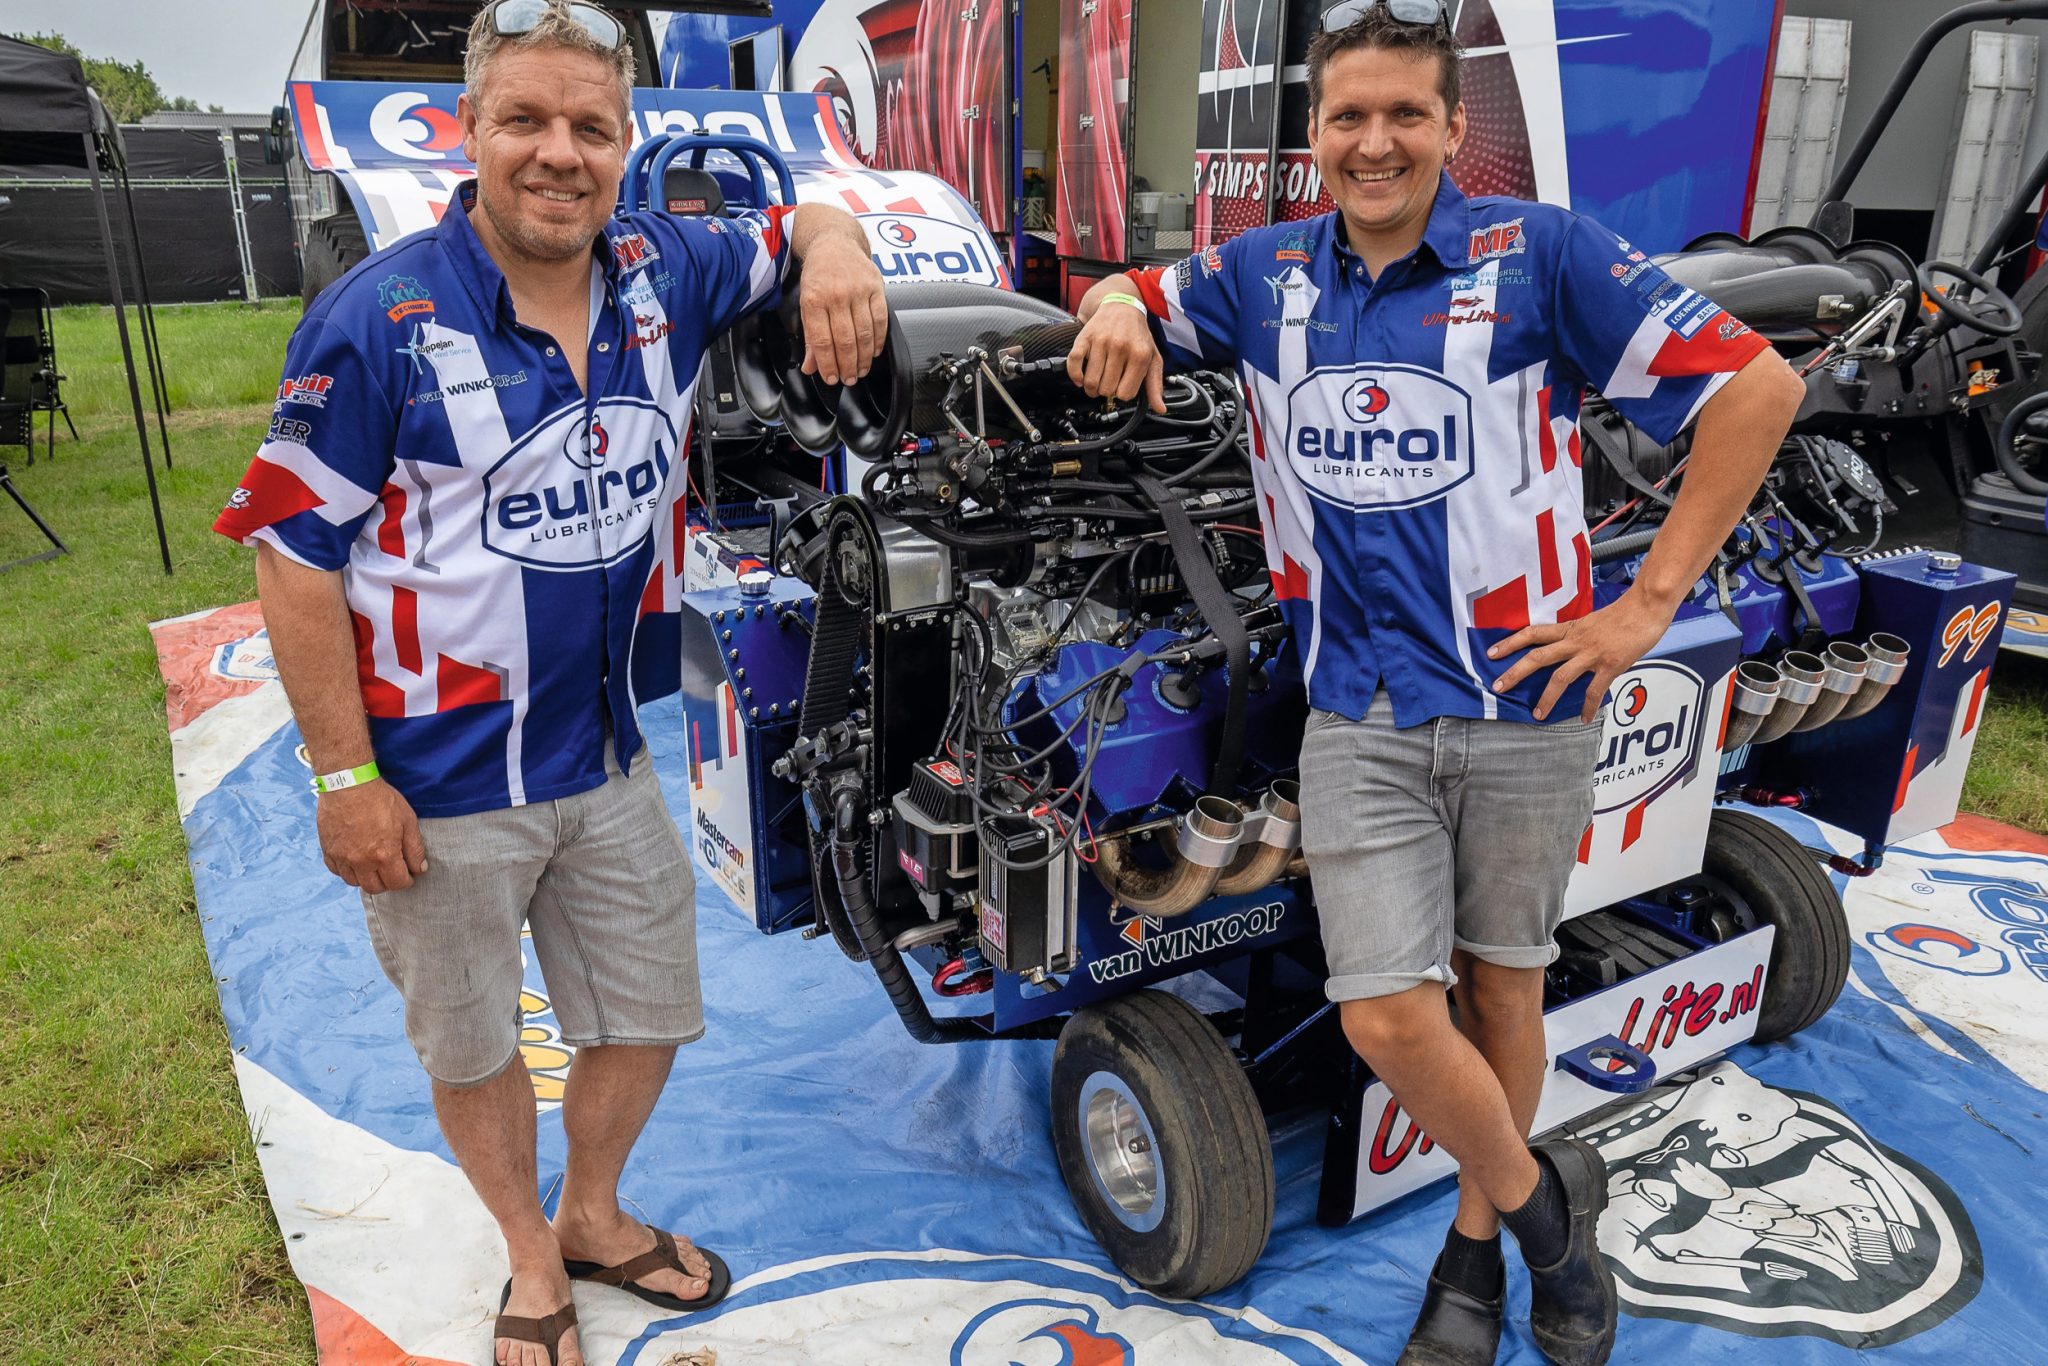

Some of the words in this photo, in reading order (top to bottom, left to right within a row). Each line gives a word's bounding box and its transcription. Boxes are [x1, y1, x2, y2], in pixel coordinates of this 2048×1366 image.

[1207, 160, 1267, 201] SIMPS
[872, 242, 983, 277] urol
[390, 287, 417, 303] KK
[393, 303, 430, 317] TECHNIEK
[414, 338, 454, 356] Koppejan
[420, 390, 445, 403] van
[1296, 415, 1457, 463] eurol
[497, 438, 670, 530] eurol
[1313, 463, 1434, 478] LUBRICANTS
[530, 497, 657, 543] LUBRICANTS
[1936, 599, 2002, 669] 99
[1594, 704, 1688, 773] urol
[1593, 758, 1664, 788] BRICANTS
[697, 806, 744, 869] Mastercam
[1088, 950, 1142, 984] van
[1144, 901, 1285, 967] WINKOOP
